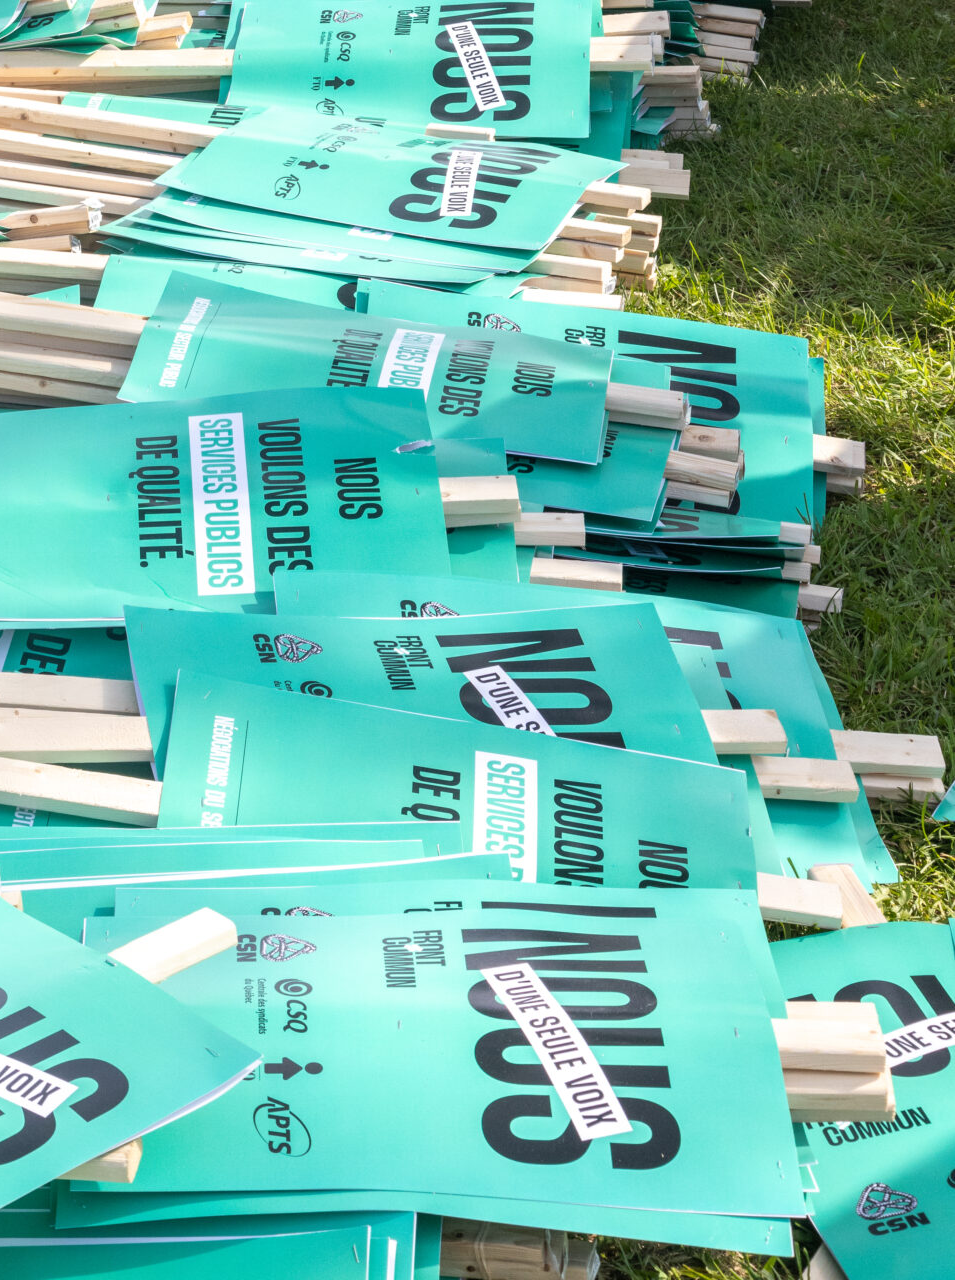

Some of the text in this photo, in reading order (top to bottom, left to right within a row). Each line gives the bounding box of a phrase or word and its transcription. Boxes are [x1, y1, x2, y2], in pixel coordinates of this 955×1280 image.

[319, 9, 333, 24] CSN
[394, 9, 414, 36] COMMUN
[415, 5, 431, 25] FRONT
[336, 42, 352, 62] CSQ
[430, 2, 535, 122] NOUS
[451, 25, 500, 107] D'UNE SEULE VOIX
[310, 76, 322, 91] FTQ
[389, 142, 561, 230] NOUS
[446, 164, 472, 213] SEULE VOIX
[467, 311, 482, 327] CS
[585, 325, 606, 348] FRO
[438, 339, 495, 417] VOULONS DES
[512, 361, 556, 398] NOUS
[128, 434, 194, 568] DE QUALITÉ.
[198, 418, 244, 589] SERVICES PUBLICS
[257, 418, 314, 576] VOULONS DES
[333, 457, 383, 520] NOUS
[252, 633, 277, 664] CSN
[373, 640, 417, 691] COMMUN
[396, 634, 434, 669] FRONT
[475, 671, 530, 719] D'UNE
[204, 714, 235, 809] NÉGOCIATIONS DU
[412, 765, 461, 800] DE
[487, 759, 525, 855] SERVICES
[554, 779, 605, 888] VOULON
[236, 934, 257, 963] CSN
[382, 936, 417, 989] COMMUN
[412, 928, 447, 966] FRONT
[243, 985, 254, 1004] Québec
[257, 978, 268, 1035] Centrale des syndicats
[283, 999, 308, 1033] CSQ
[461, 928, 682, 1170] NOUS
[494, 970, 618, 1129] D'UNE SEULE VOIX
[886, 1030, 930, 1059] UNE
[267, 1095, 292, 1155] APTS
[823, 1106, 932, 1147] COMMUN
[867, 1211, 931, 1237] CSN
